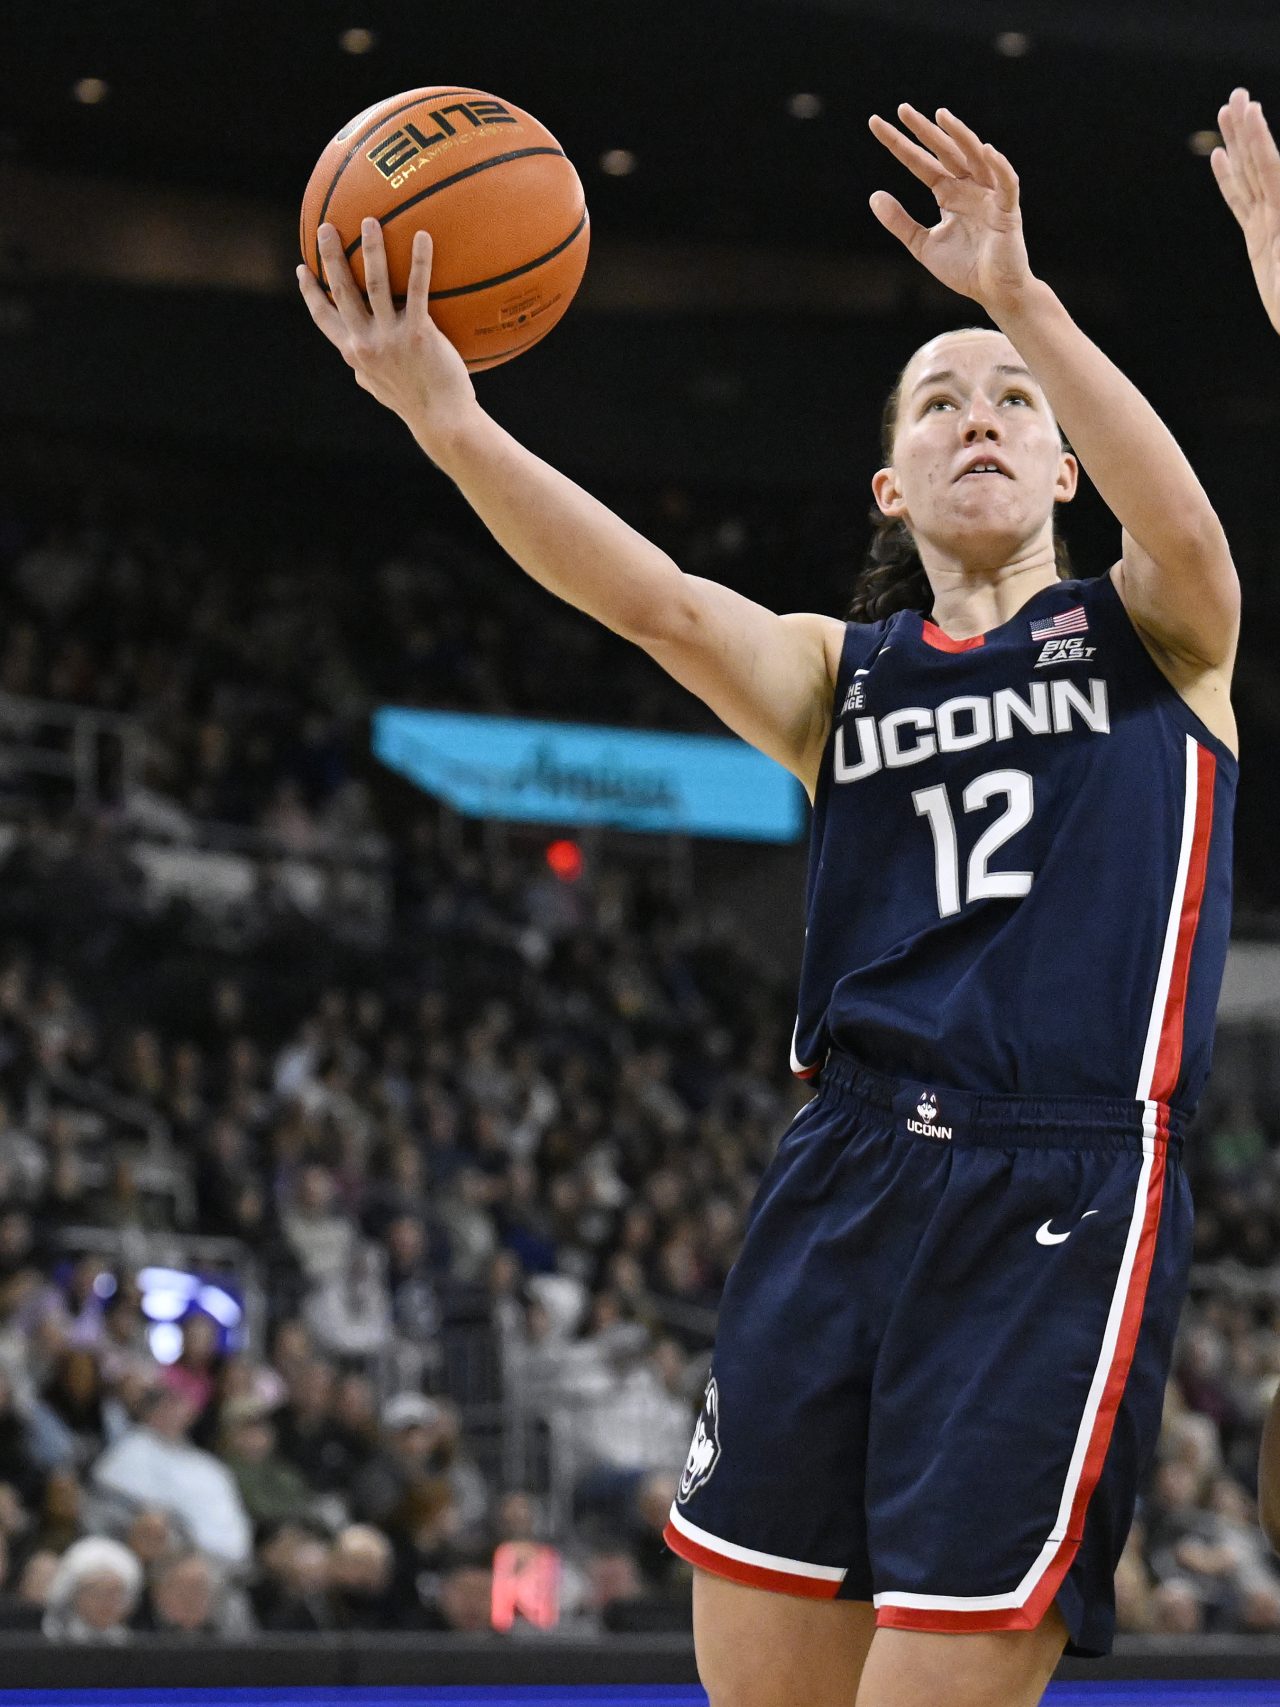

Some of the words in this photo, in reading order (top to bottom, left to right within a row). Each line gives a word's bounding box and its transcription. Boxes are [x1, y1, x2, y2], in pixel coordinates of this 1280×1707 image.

[366, 101, 518, 180] ELITE
[1036, 646, 1097, 663] EAST
[1042, 637, 1086, 652] BIG
[834, 677, 1111, 784] UCONN
[911, 768, 1035, 919] 12
[906, 1118, 952, 1140] UCONN
